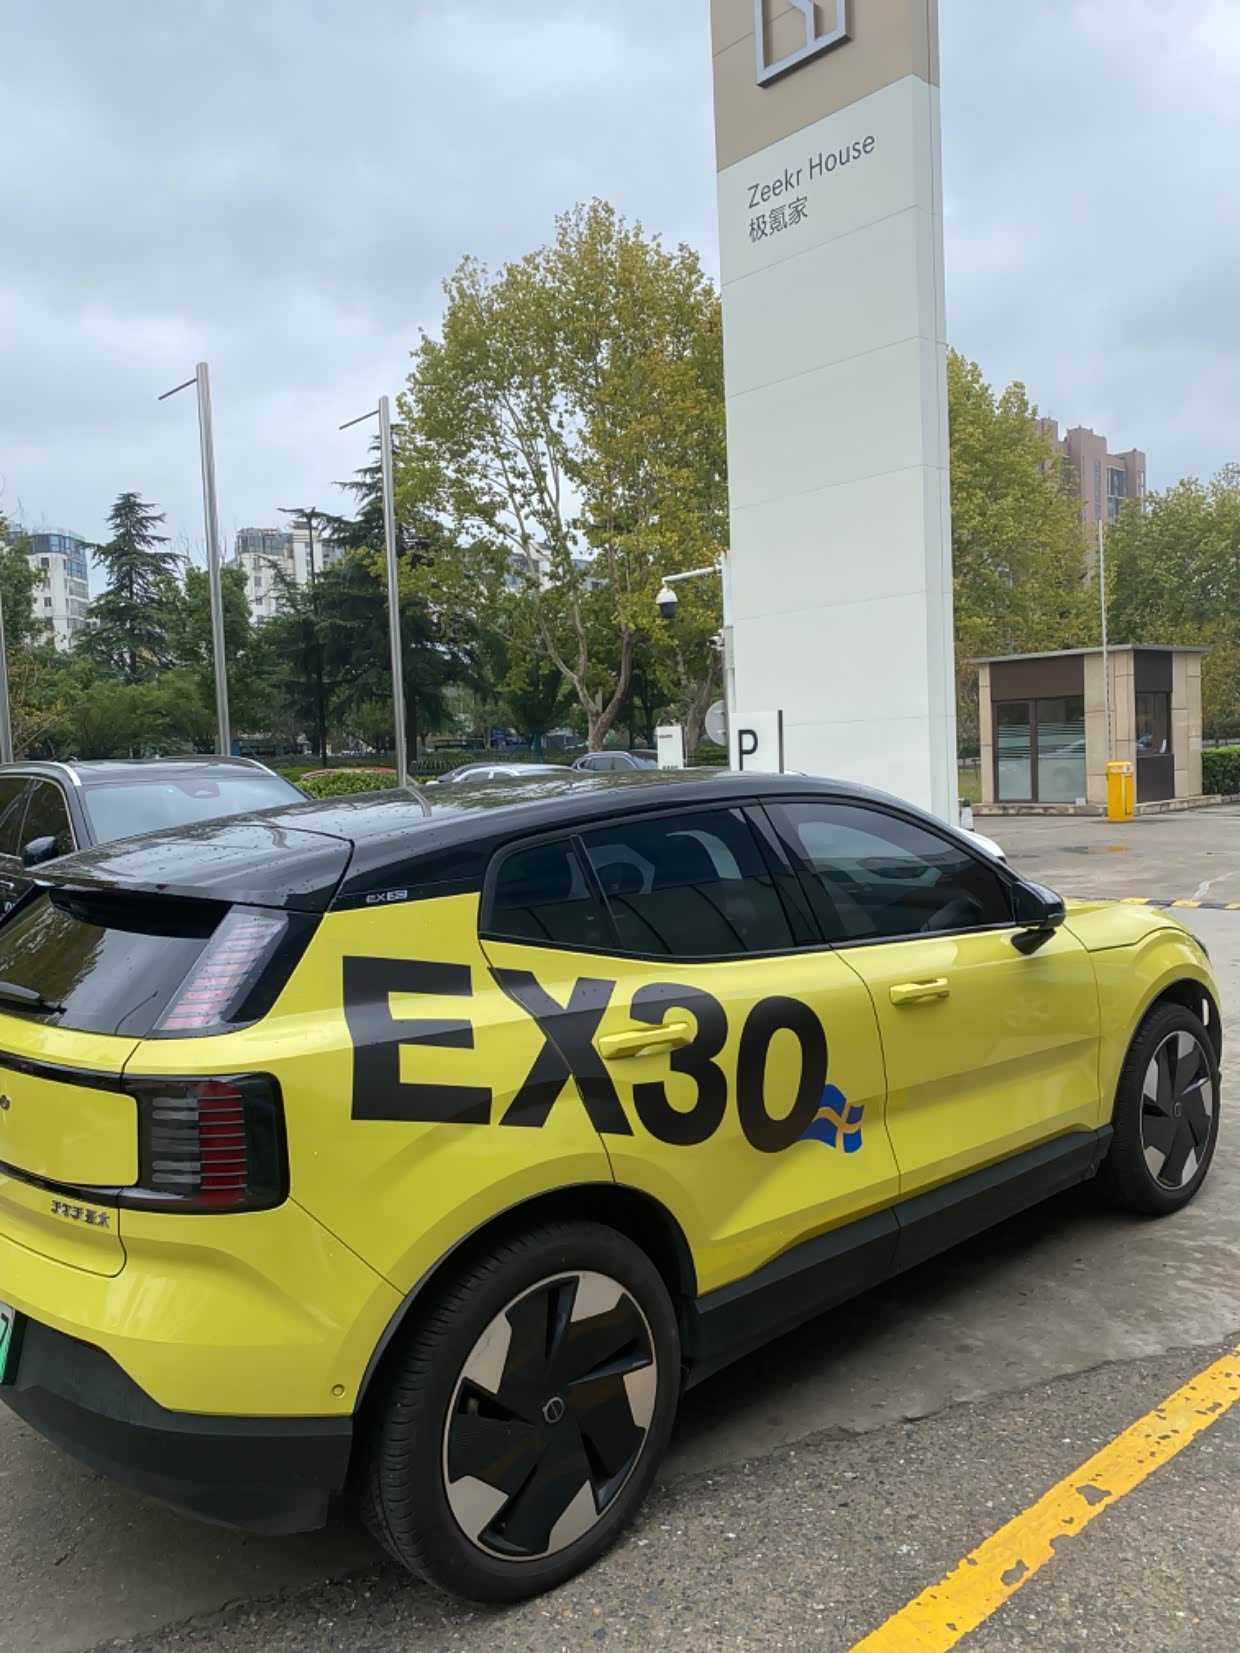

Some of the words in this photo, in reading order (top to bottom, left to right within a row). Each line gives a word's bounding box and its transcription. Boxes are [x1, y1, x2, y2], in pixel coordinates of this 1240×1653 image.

[747, 168, 802, 208] Zeekr
[809, 135, 875, 180] House
[749, 196, 808, 243] 极氪家
[738, 729, 759, 771] P
[342, 955, 829, 1153] EX30
